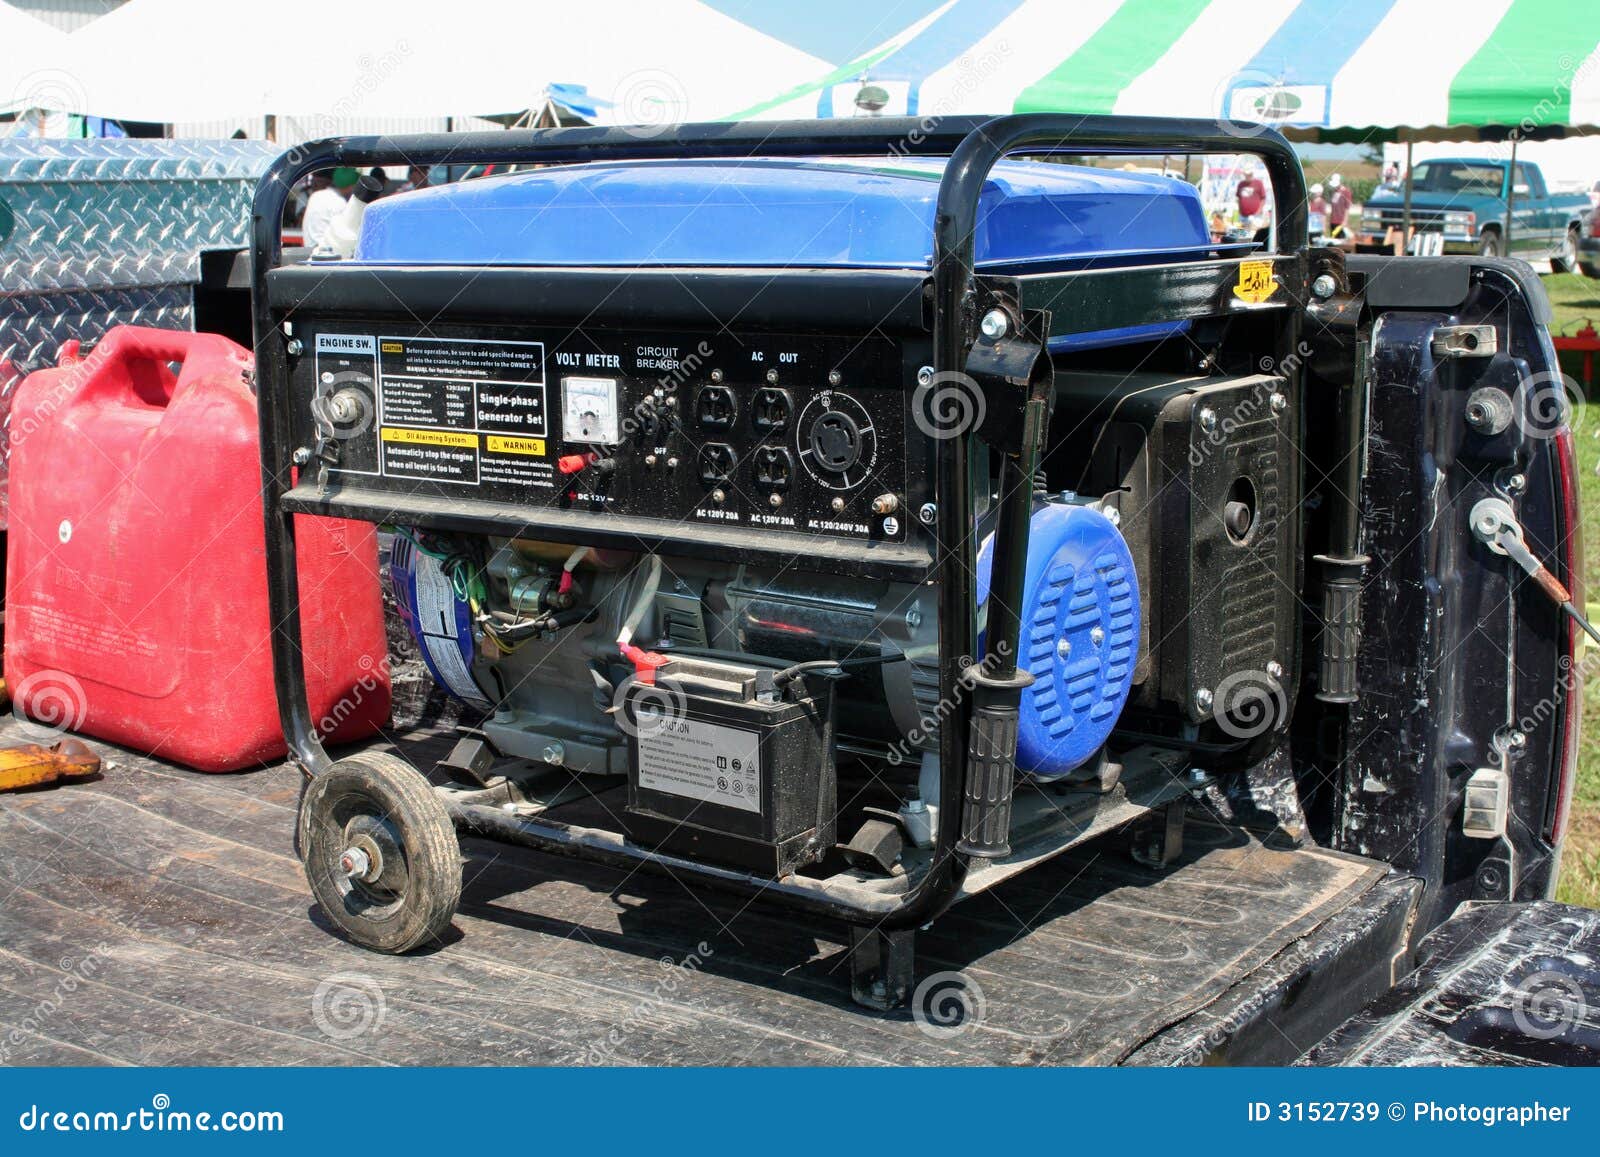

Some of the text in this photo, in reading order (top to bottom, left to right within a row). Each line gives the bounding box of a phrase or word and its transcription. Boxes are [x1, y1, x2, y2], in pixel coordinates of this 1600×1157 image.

[320, 338, 372, 349] ENGINE SW.
[424, 348, 450, 356] operation,
[636, 346, 678, 358] CIRCUIT
[751, 351, 798, 364] AC OUT
[556, 352, 620, 368] VOLT METER
[636, 358, 680, 370] BREAKER
[401, 382, 424, 390] Voltage
[401, 390, 432, 398] Frequency
[654, 388, 664, 397] ON
[402, 398, 422, 406] Output
[480, 392, 538, 408] Single-phase
[478, 410, 542, 424] Generator Set
[416, 433, 442, 442] Alarming
[444, 435, 467, 444] System
[503, 440, 538, 452] WARNING
[654, 446, 667, 456] OFF
[387, 446, 474, 462] Automaticly stop the engine
[387, 460, 462, 474] when oil level is too low.
[577, 492, 606, 502] DC 12V
[696, 508, 740, 521] AC 120V 20A
[750, 514, 795, 526] AC 120V 20A
[808, 520, 870, 534] AC 120/240V 30A
[660, 720, 690, 734] CAUTION
